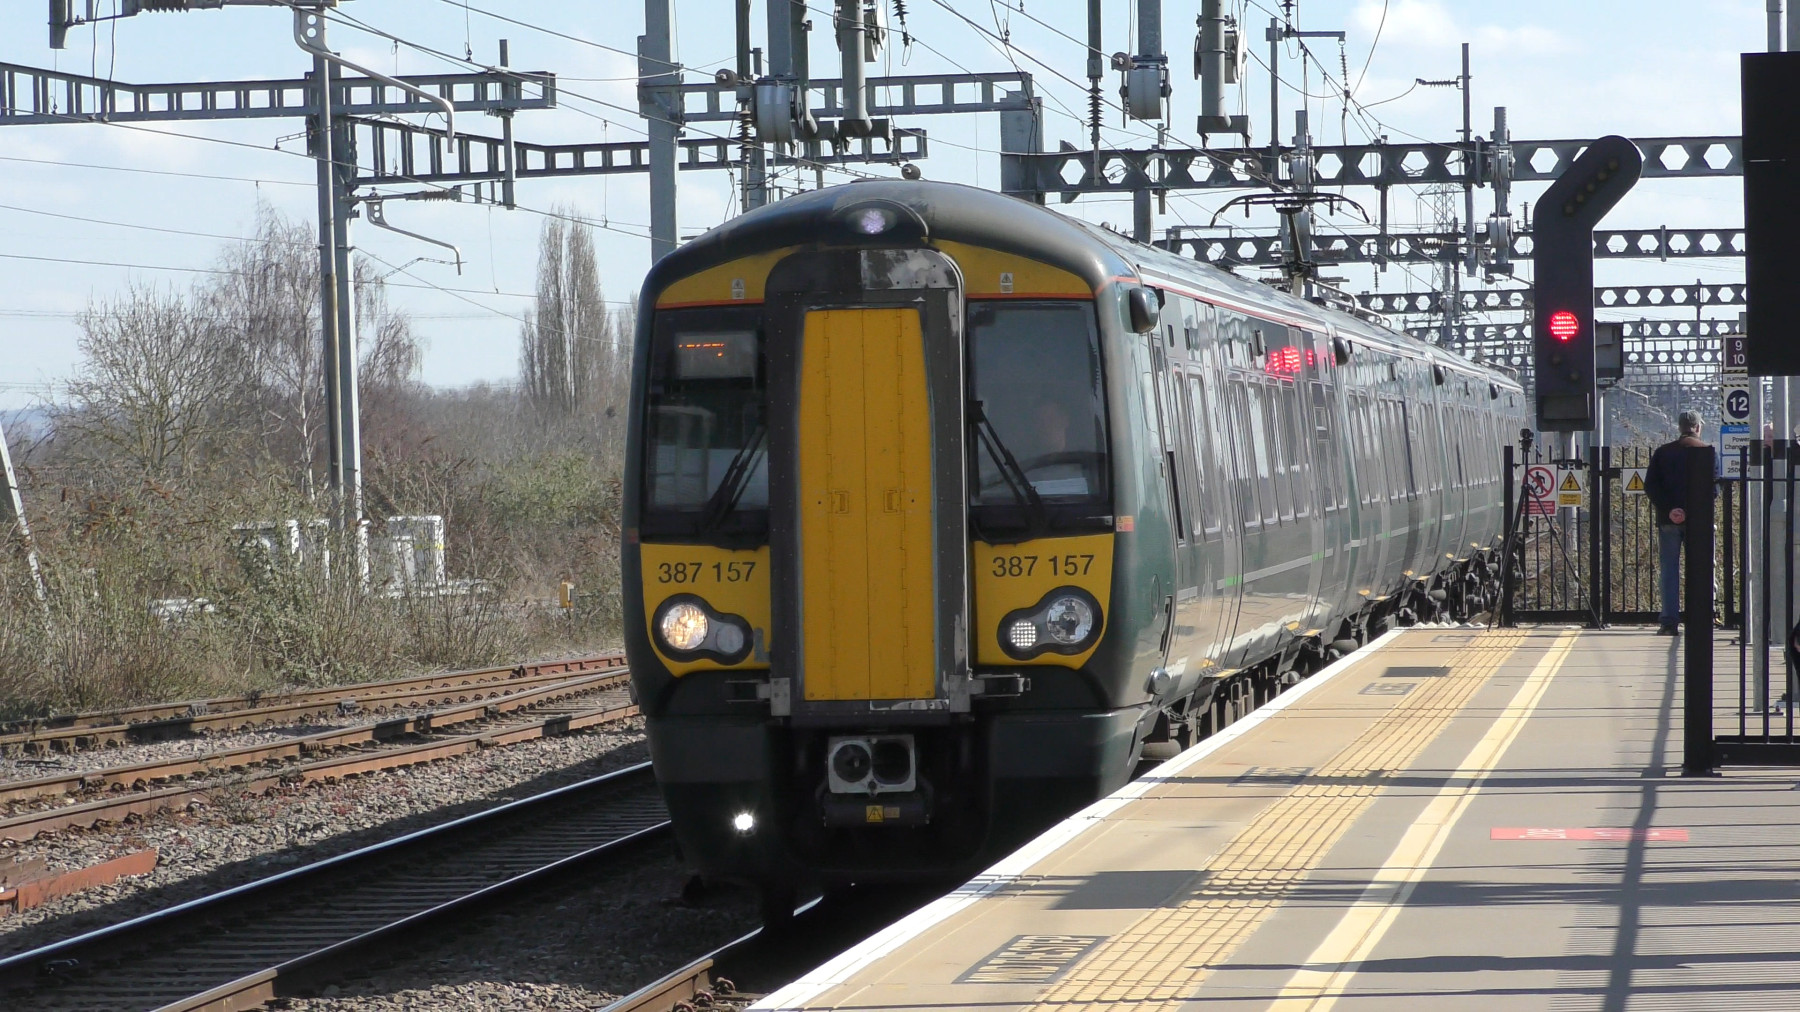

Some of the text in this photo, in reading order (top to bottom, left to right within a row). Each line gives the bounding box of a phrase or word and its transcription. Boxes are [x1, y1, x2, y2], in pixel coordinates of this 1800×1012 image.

[1734, 340, 1743, 351] 9
[1732, 354, 1746, 365] 10
[1729, 396, 1748, 411] 12
[658, 561, 756, 584] 387 157
[992, 555, 1094, 577] 387 157
[963, 935, 1097, 982] MIND THE STEP
